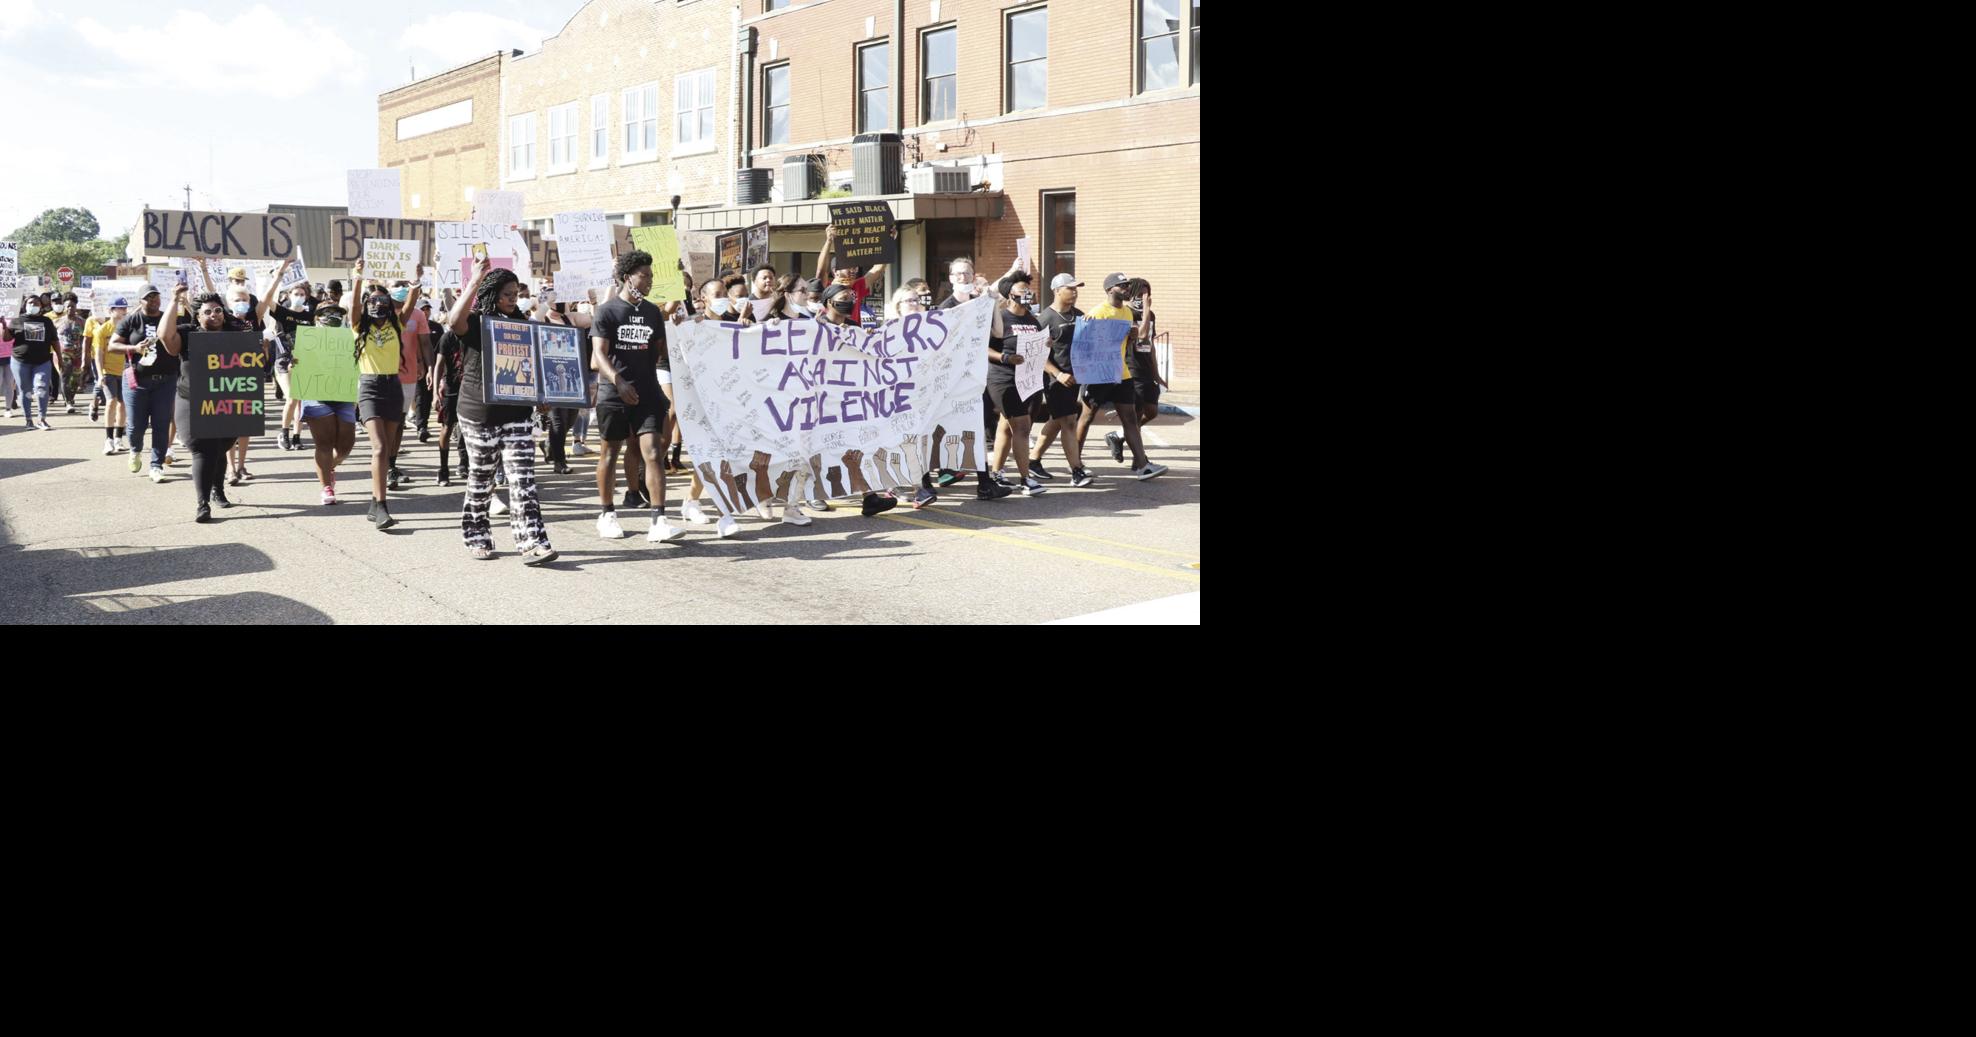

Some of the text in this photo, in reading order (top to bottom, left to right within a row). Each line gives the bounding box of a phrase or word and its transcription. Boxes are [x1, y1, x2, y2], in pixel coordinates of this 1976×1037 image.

[832, 208, 844, 216] WE
[845, 206, 862, 214] SAID
[834, 215, 884, 226] LIVES MATTER
[144, 211, 294, 258] BLACK IS
[438, 222, 512, 240] SILENCE
[836, 228, 850, 236] ELP
[864, 225, 886, 234] REACH
[370, 241, 400, 250] DARK
[842, 236, 880, 246] ALL LIVES
[366, 251, 412, 261] SKIN IS
[368, 260, 401, 269] NOT A
[58, 270, 73, 278] STOP
[372, 270, 406, 279] CRIME
[498, 343, 529, 356] PROTEST
[208, 352, 264, 370] BLACK
[778, 356, 918, 391] AGAINST
[209, 376, 258, 392] LIVES
[201, 399, 264, 416] MATTER
